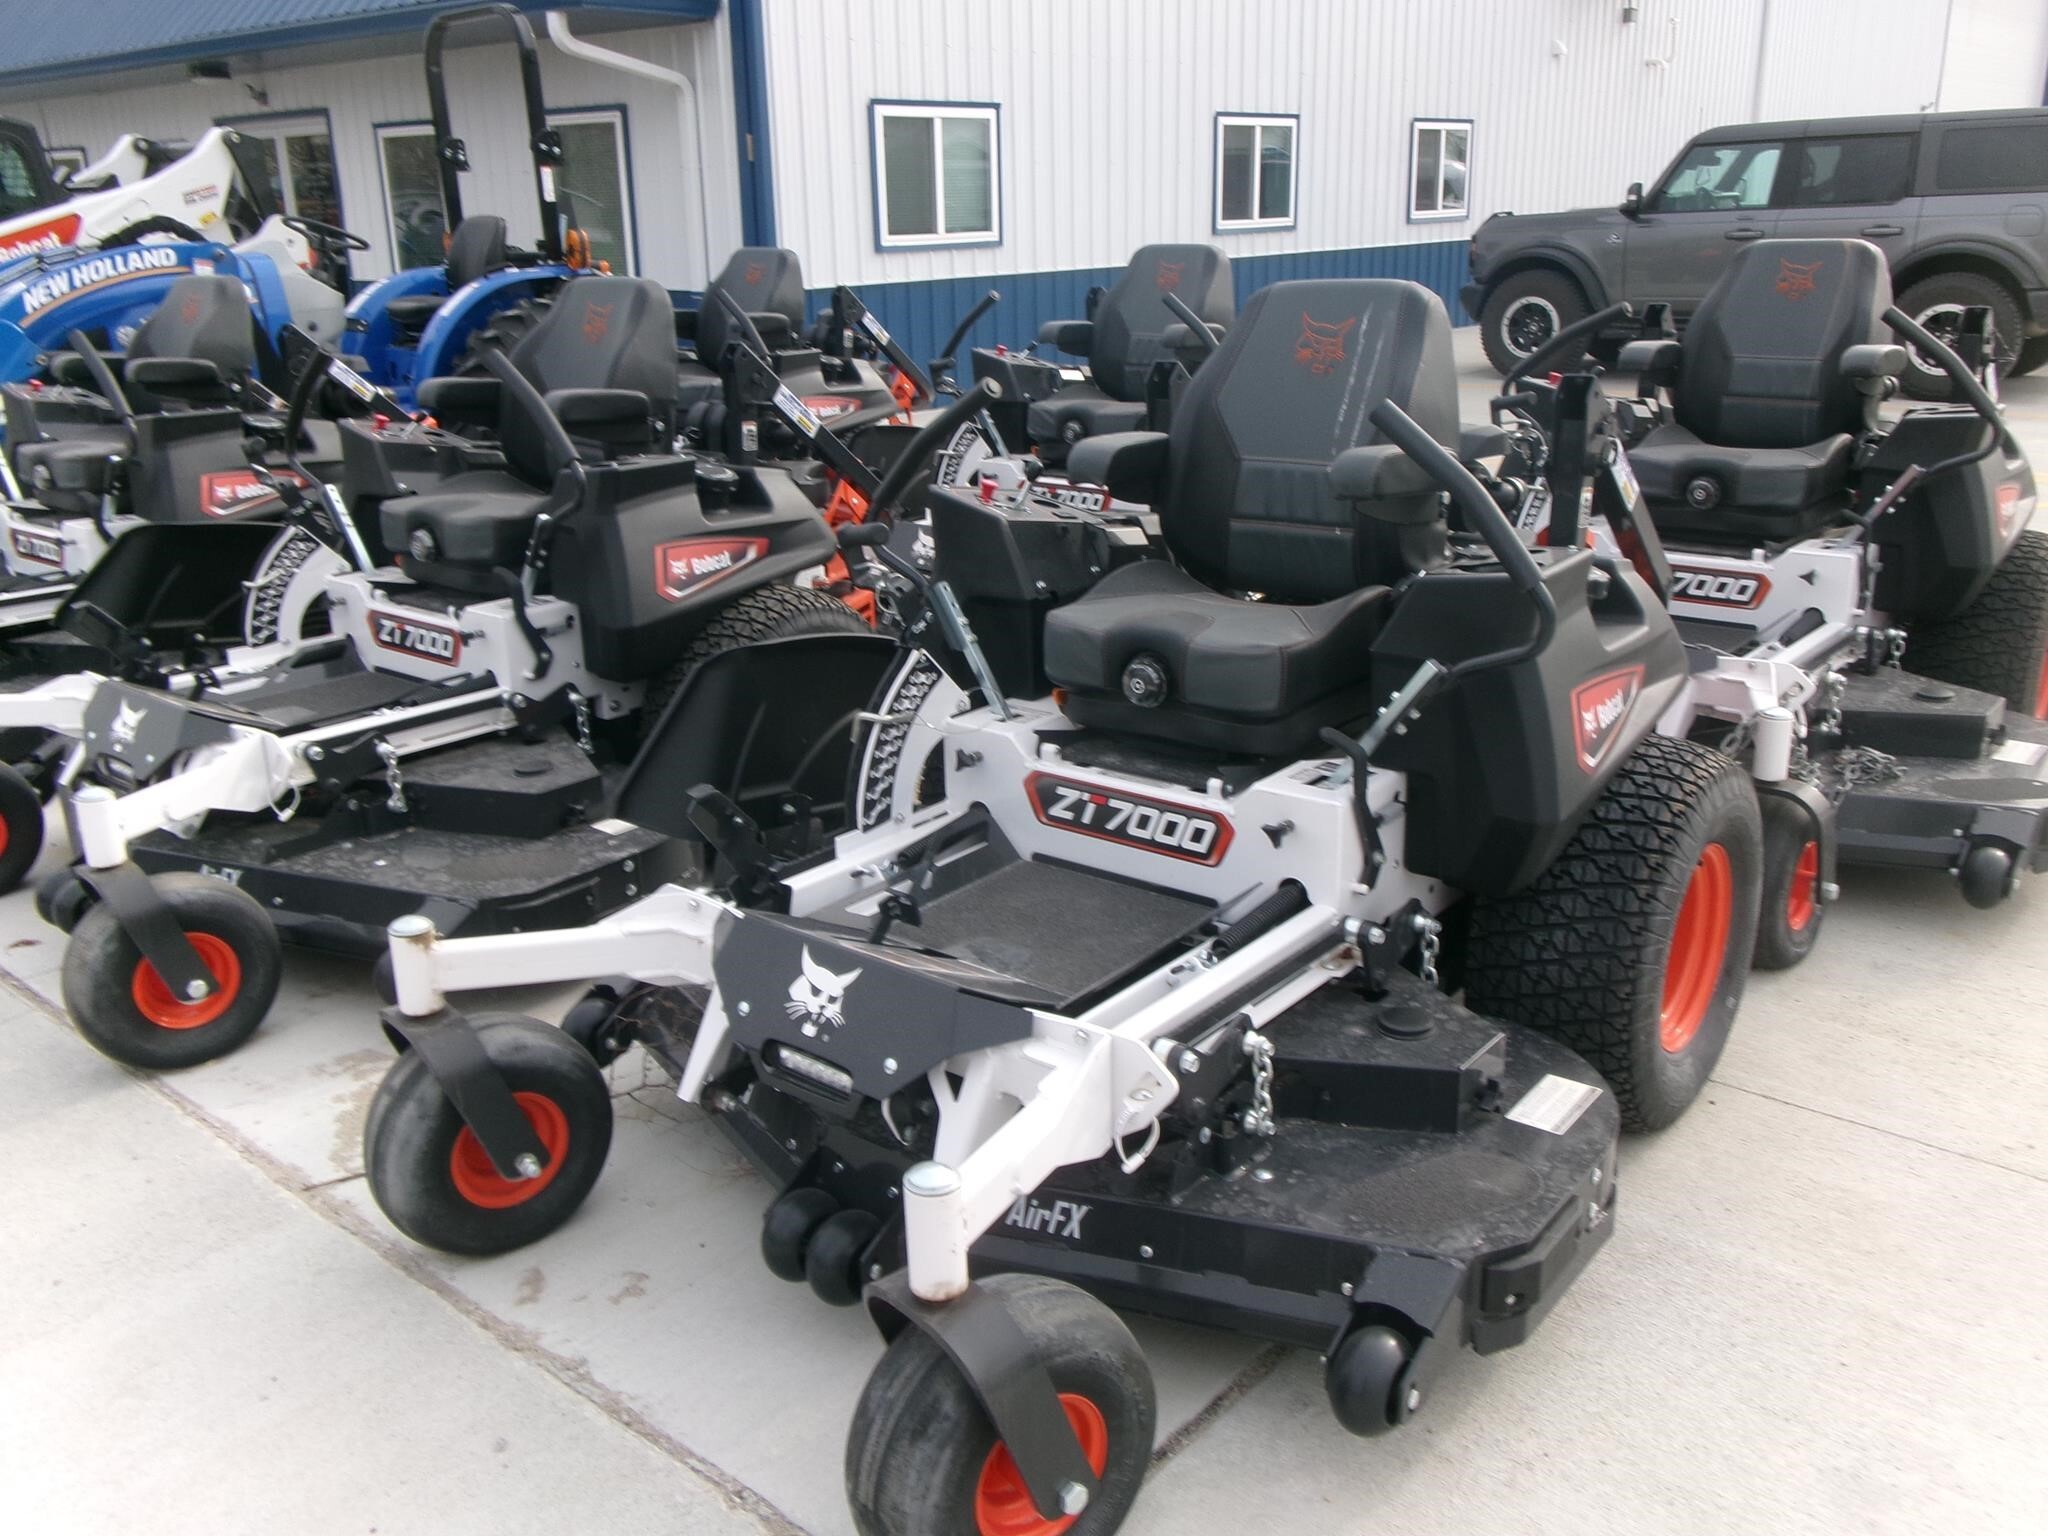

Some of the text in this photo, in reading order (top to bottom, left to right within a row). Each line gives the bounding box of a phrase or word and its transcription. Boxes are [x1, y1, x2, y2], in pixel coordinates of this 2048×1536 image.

[21, 247, 178, 314] NEW HOLLAND
[690, 550, 732, 575] Bobcat
[1596, 688, 1625, 730] Bobcat
[1005, 1193, 1090, 1240] AirFX
